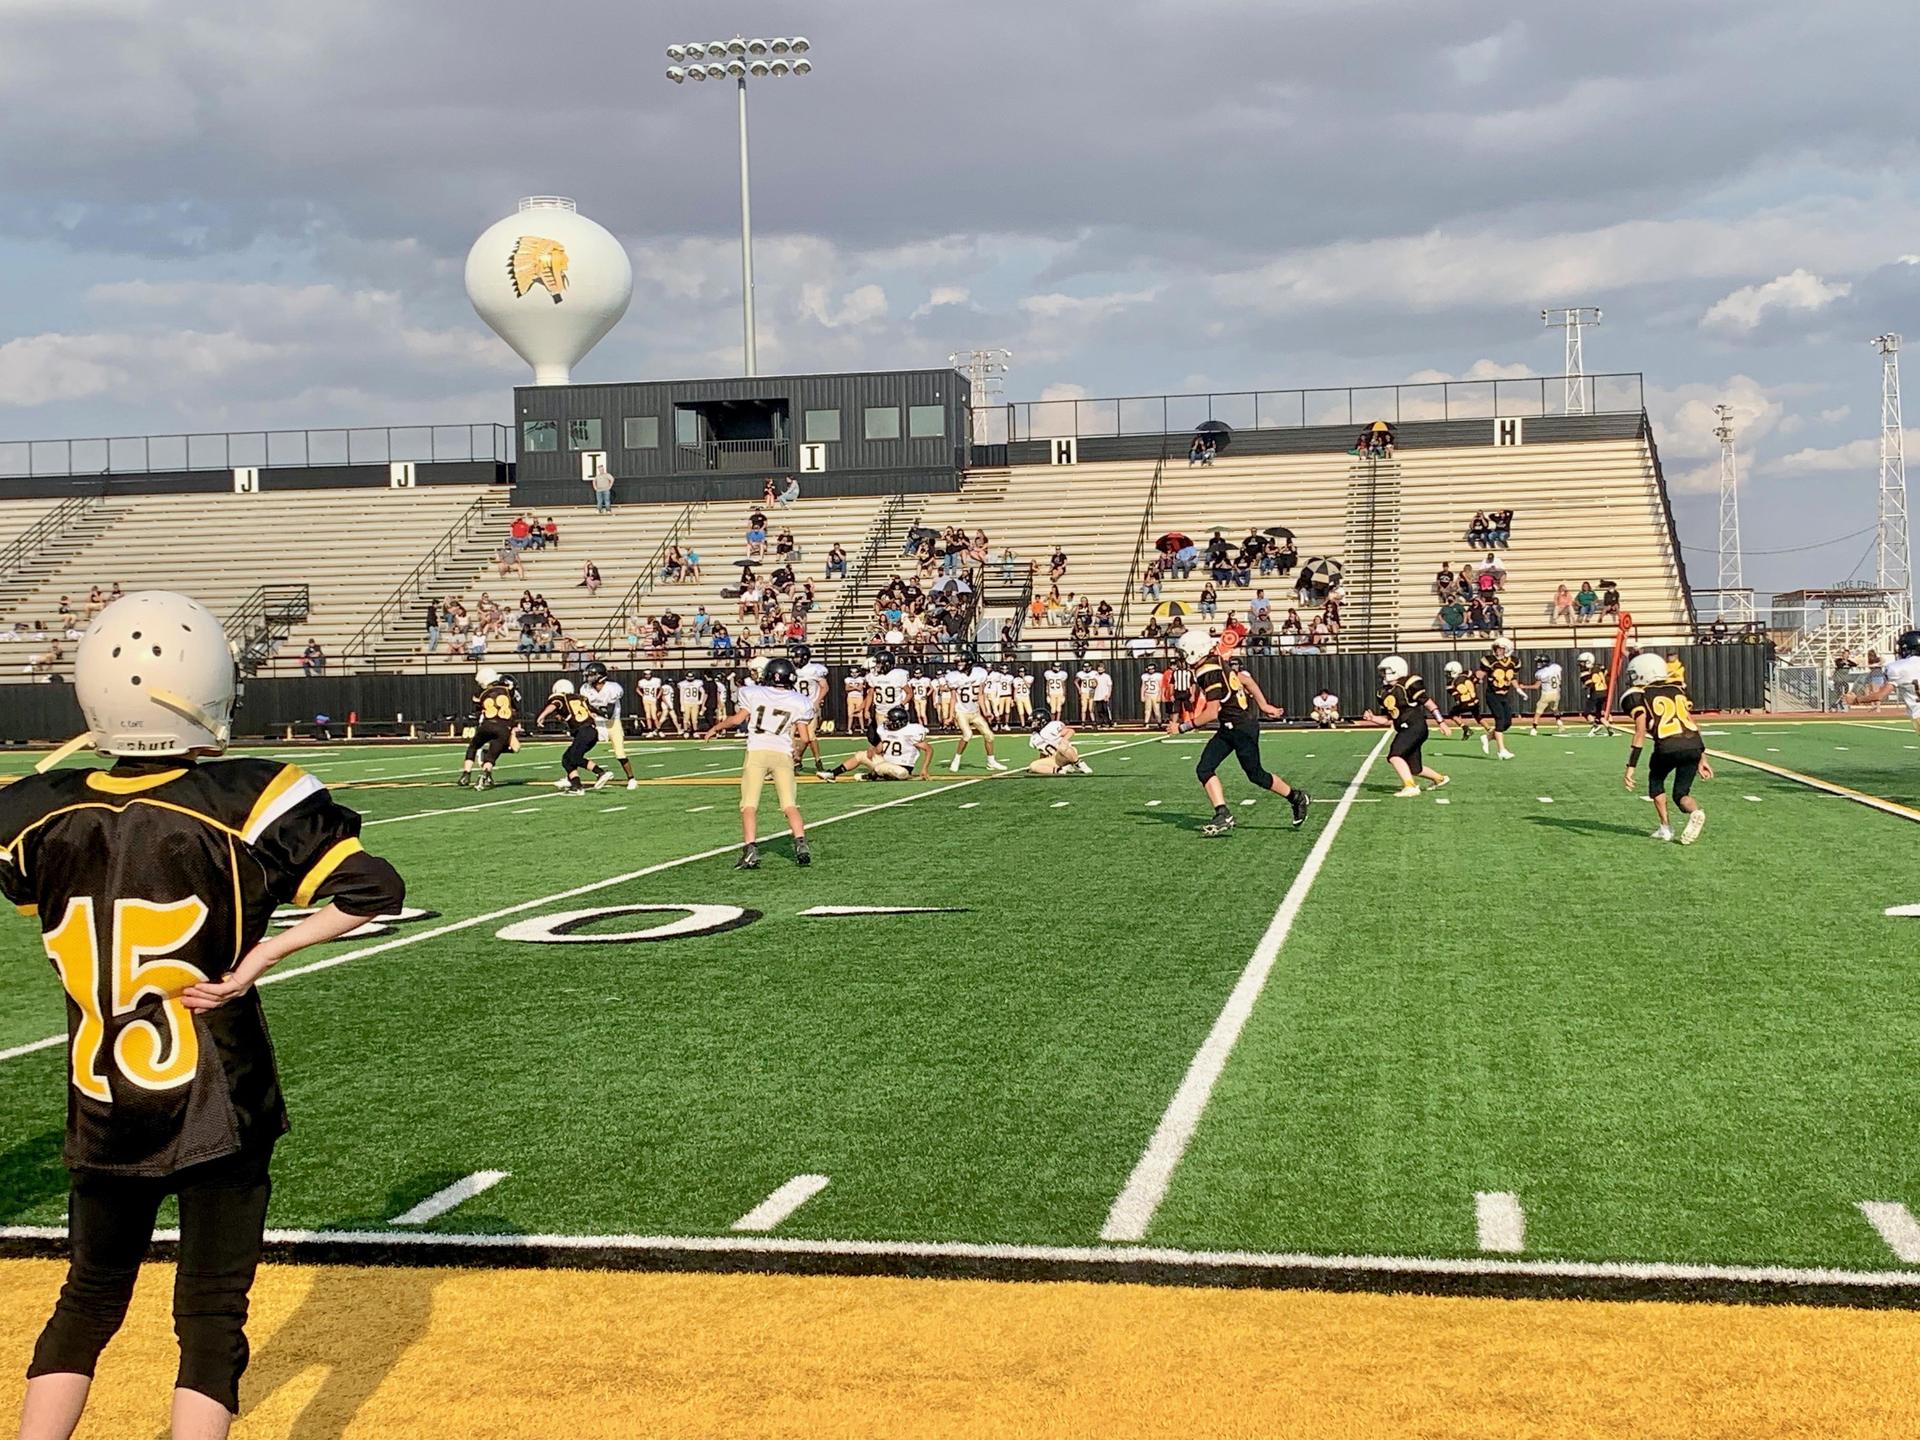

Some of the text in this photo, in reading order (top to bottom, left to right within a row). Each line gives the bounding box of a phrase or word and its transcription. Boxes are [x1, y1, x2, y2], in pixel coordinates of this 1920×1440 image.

[1501, 420, 1515, 445] H
[806, 446, 820, 470] I
[1057, 440, 1071, 464] H
[397, 464, 409, 487] J
[587, 454, 600, 478] I
[241, 469, 252, 492] J
[685, 687, 698, 698] 38
[874, 686, 896, 704] 69
[960, 684, 980, 704] 65
[754, 704, 791, 736] 17
[881, 740, 903, 757] 78
[42, 895, 209, 1102] 15
